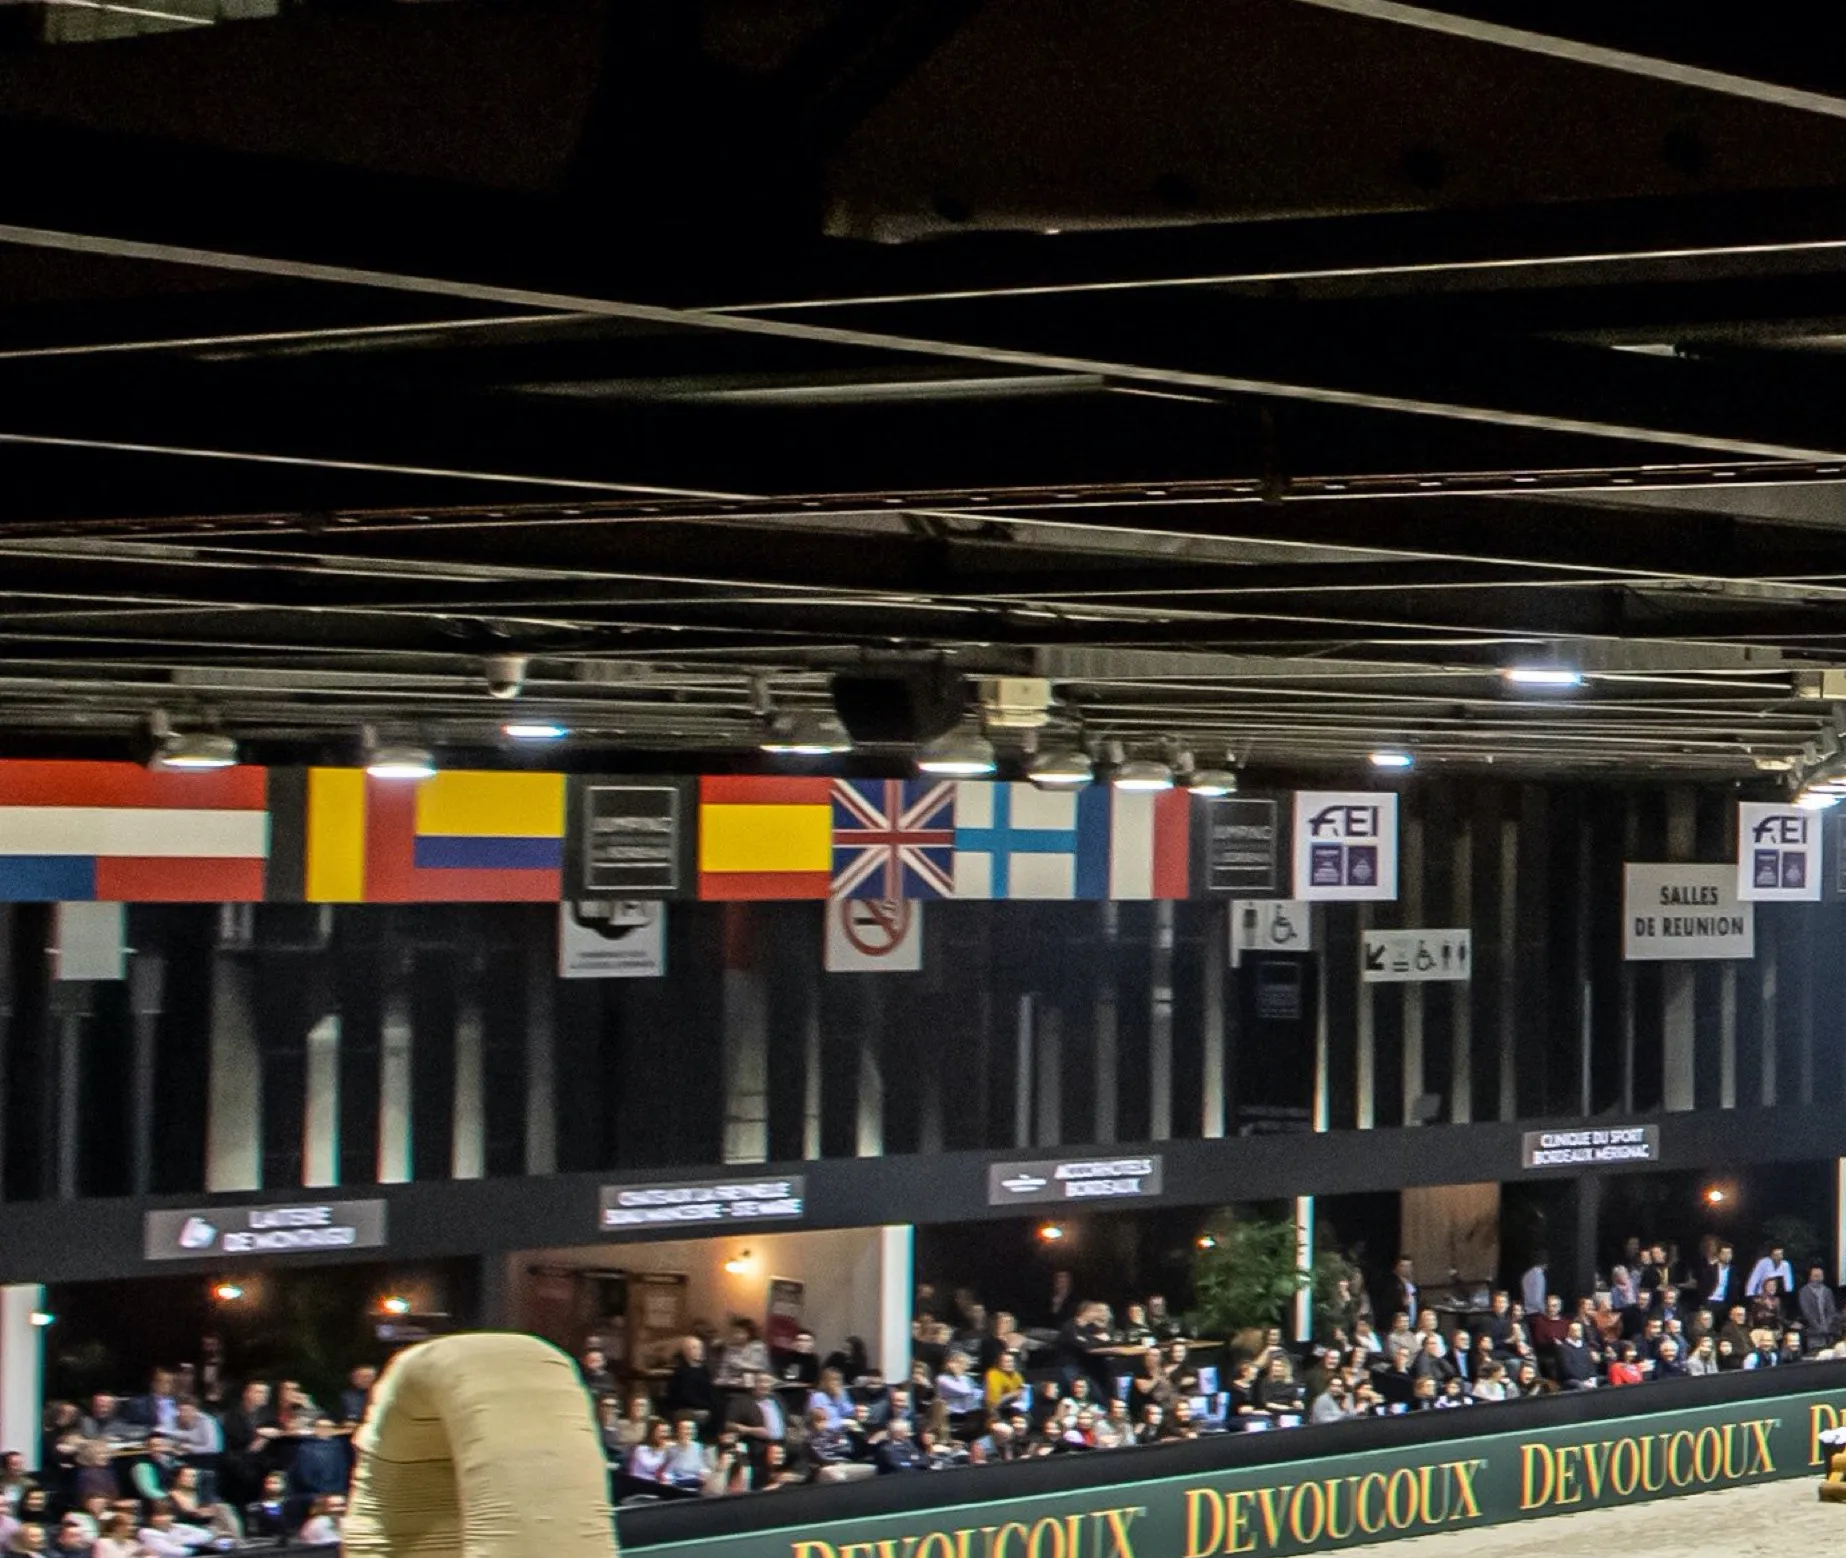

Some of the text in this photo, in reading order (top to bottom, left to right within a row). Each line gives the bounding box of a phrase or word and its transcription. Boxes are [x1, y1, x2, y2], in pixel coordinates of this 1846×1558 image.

[1309, 805, 1378, 836] FEI
[1752, 816, 1807, 844] FEI
[1660, 886, 1719, 905] SALLES
[1635, 917, 1744, 937] DE REUNION
[1519, 1418, 1780, 1510] DEVOUCOUX
